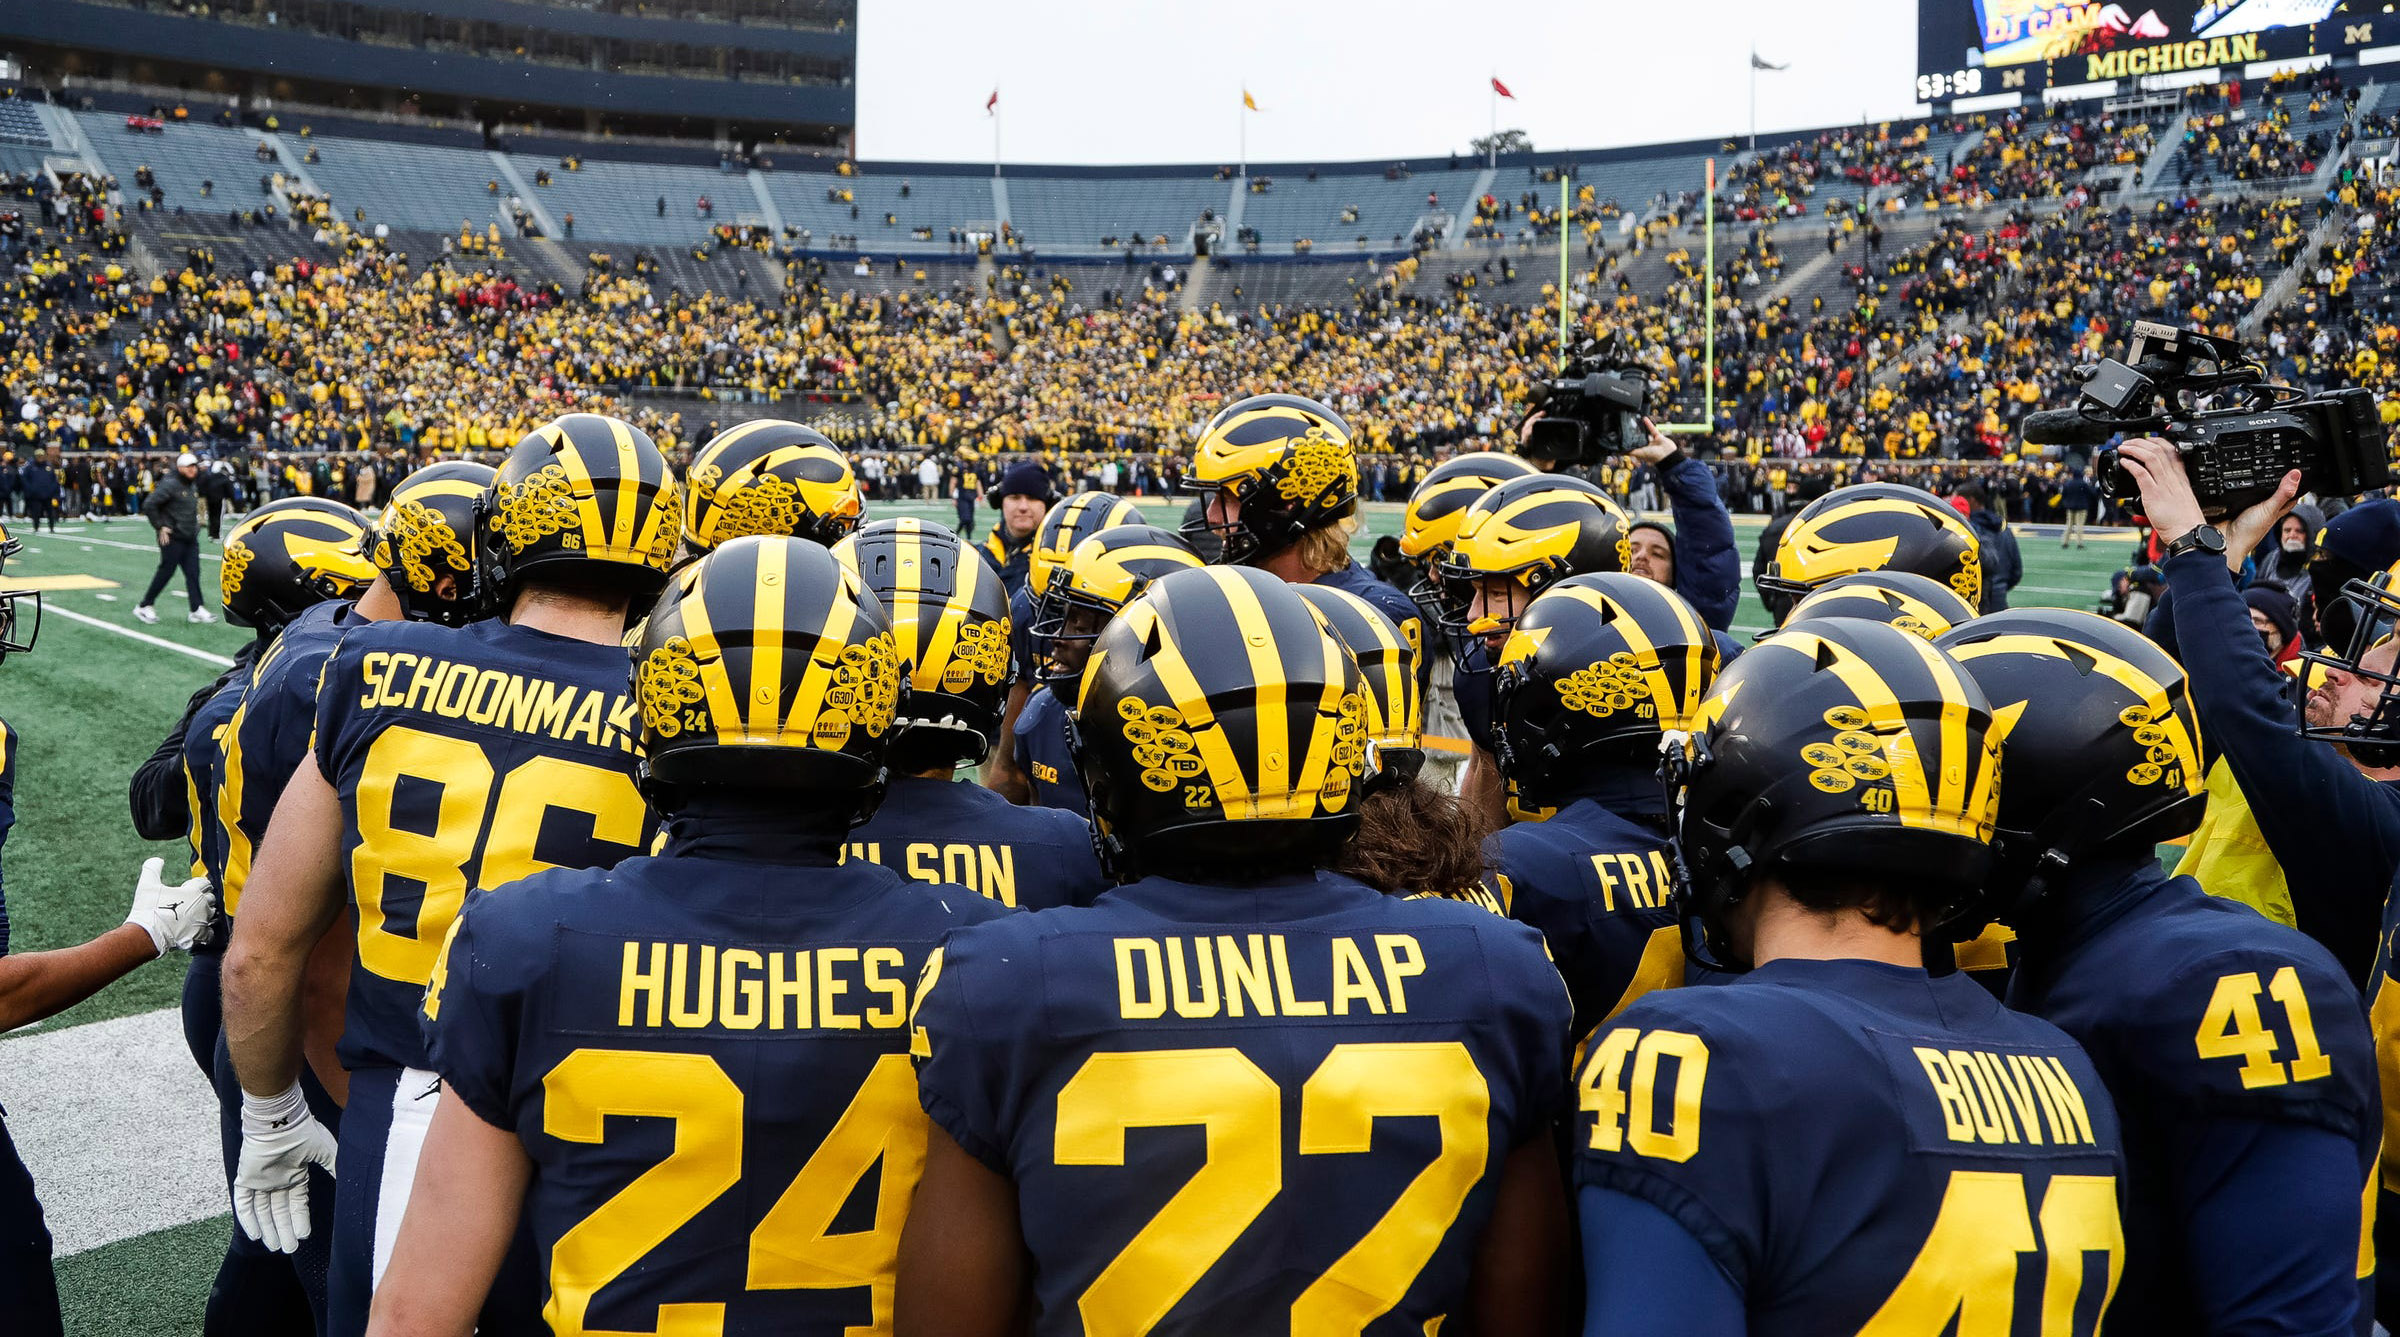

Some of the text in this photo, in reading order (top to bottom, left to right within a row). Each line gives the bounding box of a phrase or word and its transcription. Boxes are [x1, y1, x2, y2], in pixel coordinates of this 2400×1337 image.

[2248, 417, 2278, 426] SONY
[562, 532, 581, 550] 86
[965, 628, 980, 638] TED
[830, 691, 854, 705] (630)
[1591, 705, 1609, 714] TED
[1634, 703, 1654, 719] 40
[684, 709, 707, 732] 24
[1340, 723, 1354, 736] TED
[816, 731, 847, 739] EQUALITY
[1172, 760, 1199, 771] TED
[2165, 768, 2180, 789] 41
[1184, 786, 1212, 808] 22
[1861, 787, 1893, 813] 40
[618, 941, 907, 1031] HUGHES
[1113, 934, 1427, 1020] DUNLAP
[2194, 966, 2332, 1090] 41
[1579, 1027, 1711, 1164] 40
[1912, 1046, 2096, 1147] BOIVIN
[542, 1048, 929, 1337] 24
[1053, 1041, 1490, 1337] 22
